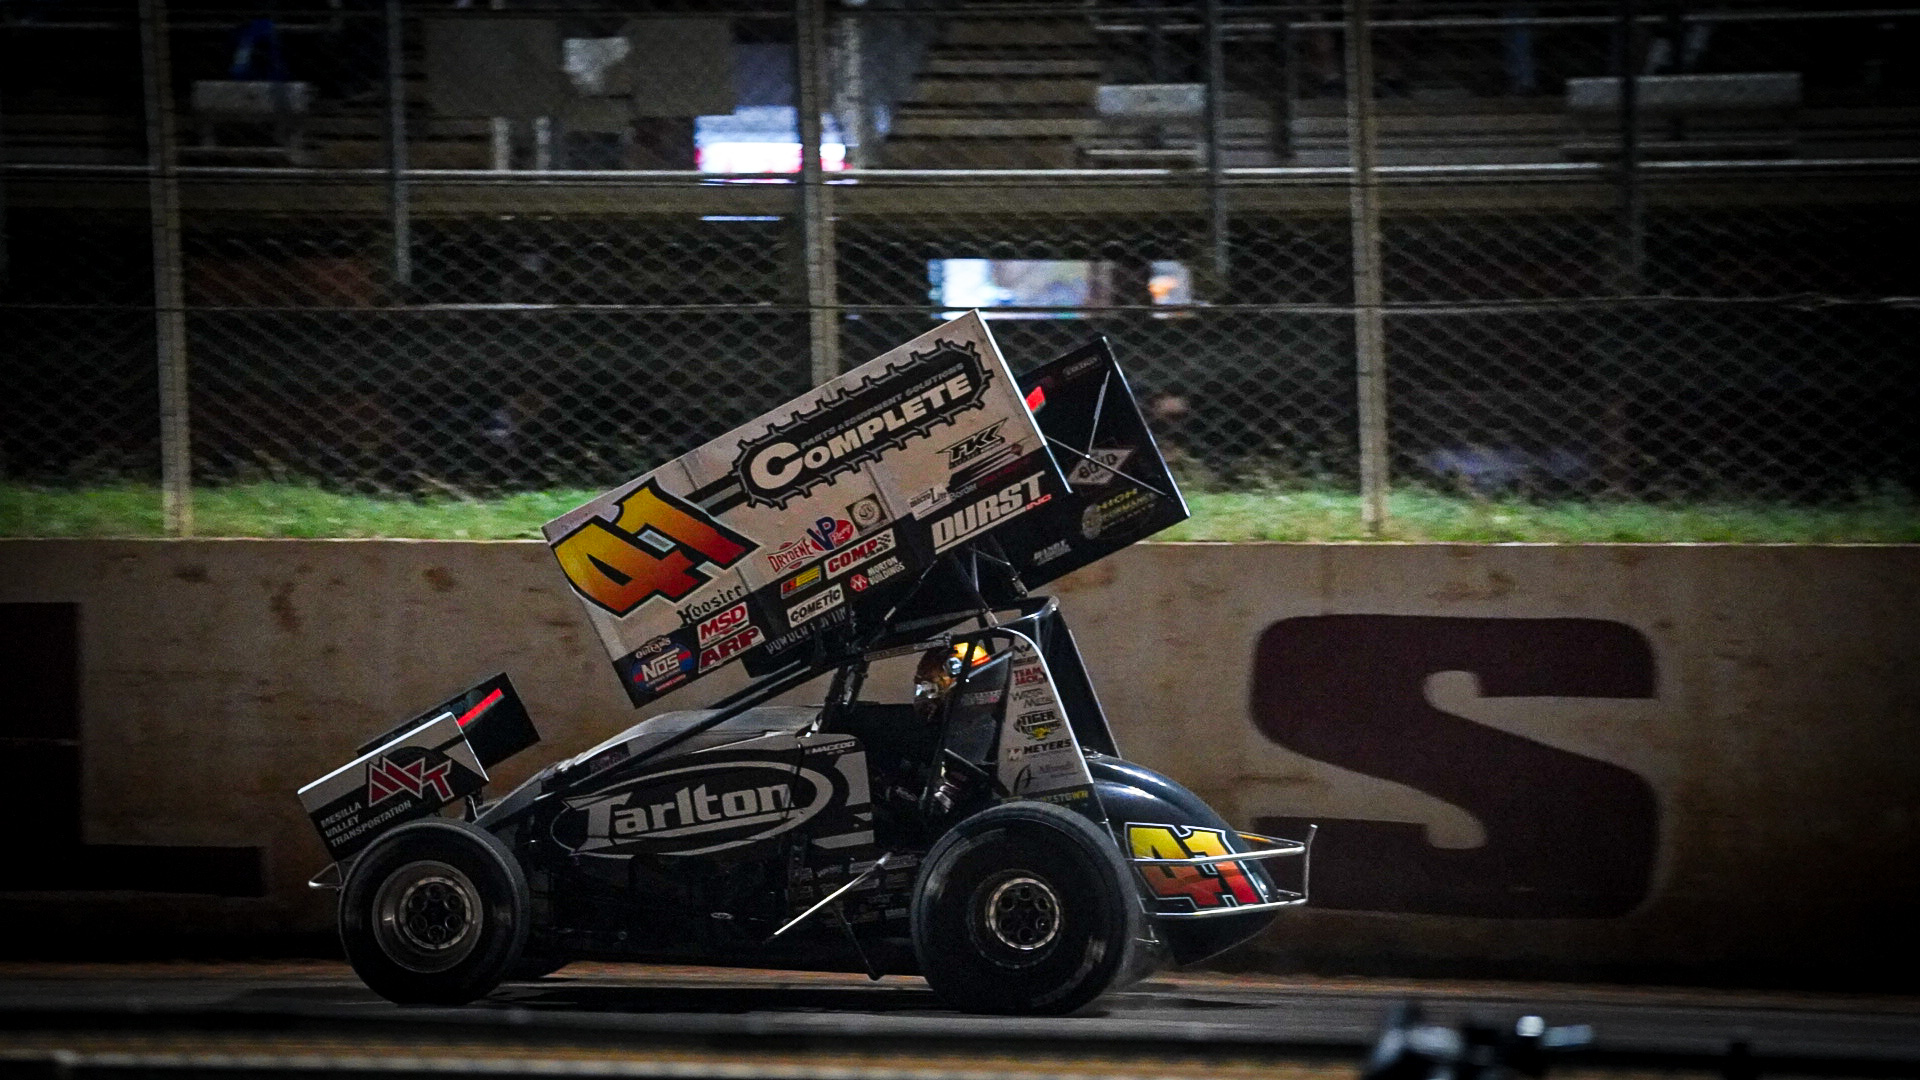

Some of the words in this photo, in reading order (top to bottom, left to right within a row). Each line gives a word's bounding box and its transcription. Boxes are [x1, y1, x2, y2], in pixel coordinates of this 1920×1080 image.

[750, 372, 972, 489] COMPLETE
[931, 470, 1045, 548] DURST
[551, 478, 758, 617] 41
[806, 516, 836, 550] VP
[768, 537, 814, 573] DRYDENE
[828, 539, 878, 573] COMP
[676, 585, 742, 627] Hoosier
[701, 604, 746, 641] MSD
[641, 649, 680, 682] NOS
[701, 628, 759, 667] ARP
[1020, 710, 1055, 726] TIGER
[1023, 739, 1072, 755] MEYERS
[1249, 614, 1657, 919] S
[320, 801, 362, 828] MESILLA
[325, 814, 360, 838] VALLEY
[330, 799, 412, 848] TRANSPORTATION
[561, 783, 795, 851] Tarlton
[1126, 822, 1263, 910] 41
